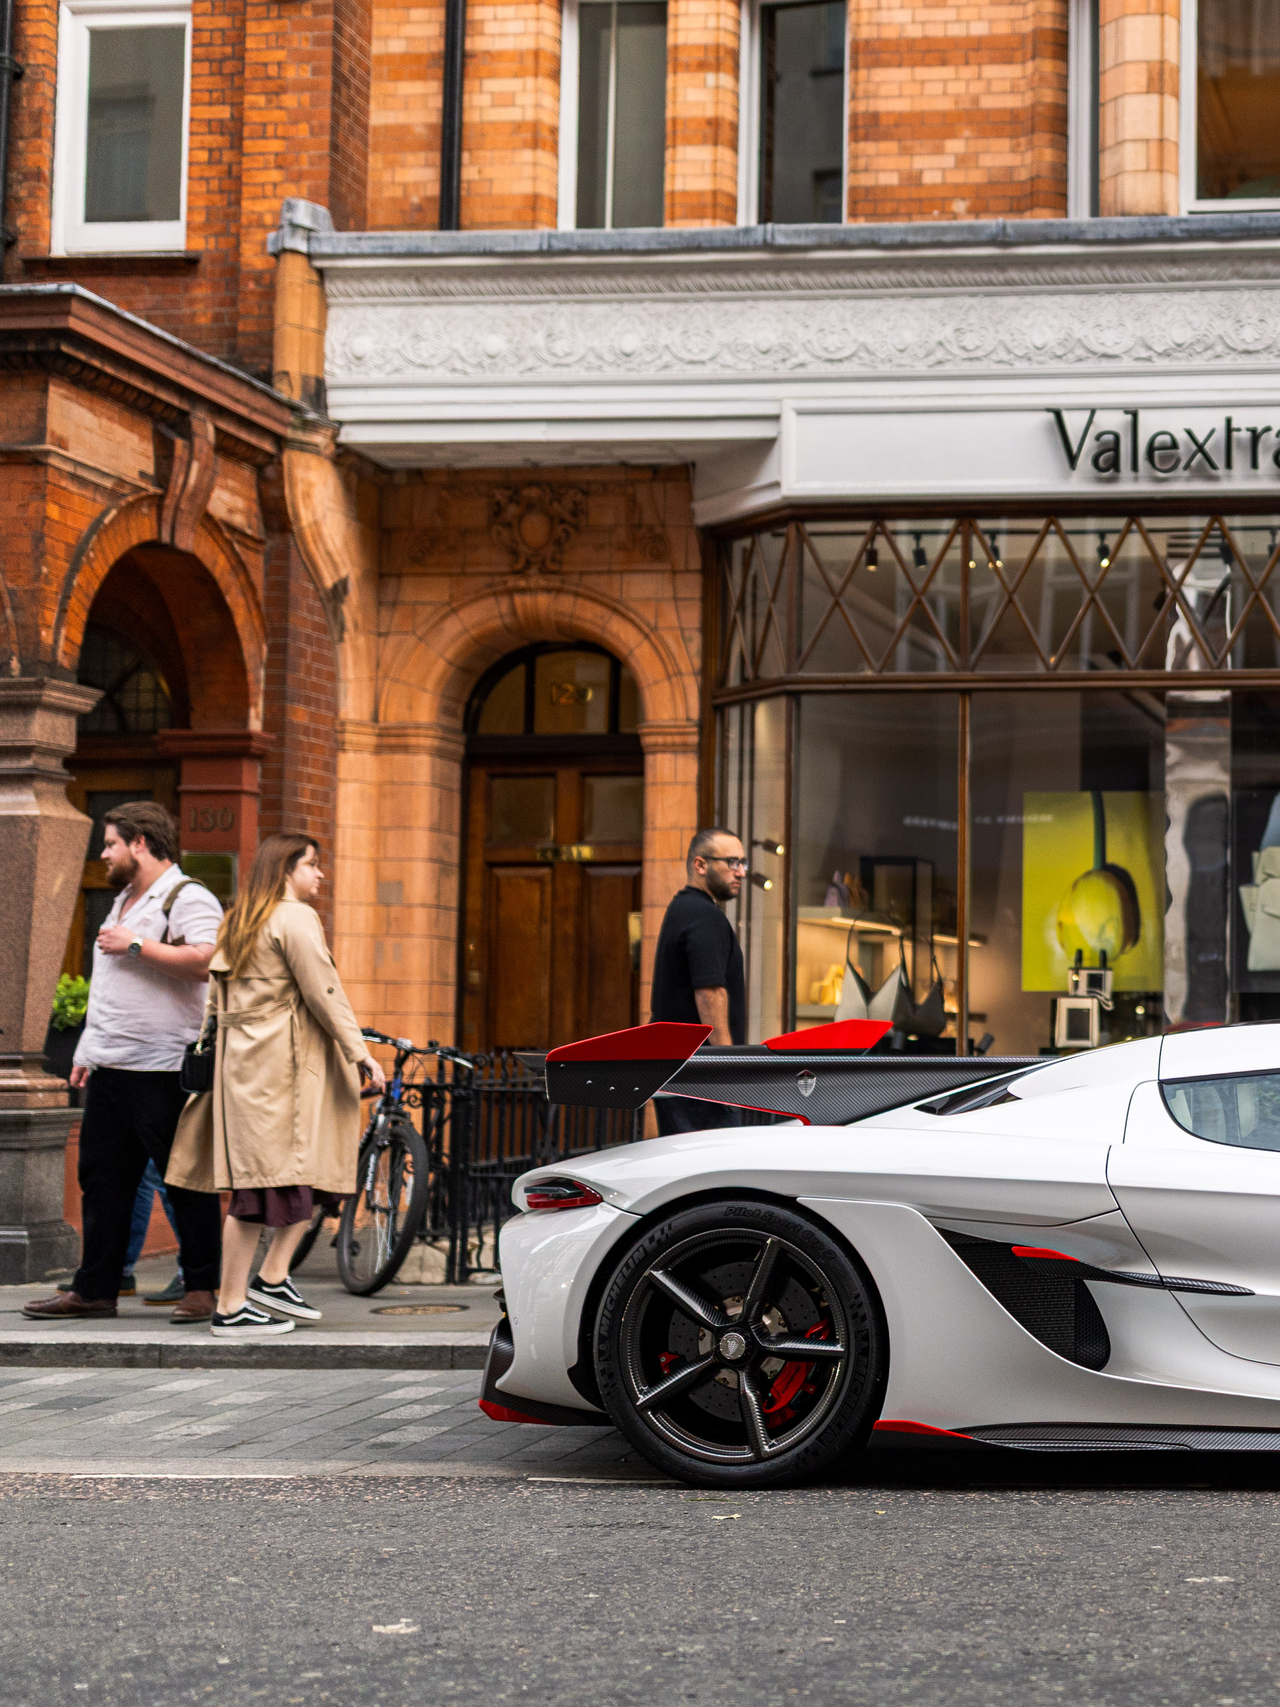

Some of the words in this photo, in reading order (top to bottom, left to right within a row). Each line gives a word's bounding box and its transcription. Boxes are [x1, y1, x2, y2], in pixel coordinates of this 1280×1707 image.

[190, 807, 235, 833] 130
[724, 1206, 761, 1218] Pilot
[761, 1209, 803, 1233] Sport
[801, 1229, 825, 1251] Cup
[823, 1248, 837, 1261] 2
[600, 1245, 646, 1338] MICHELIN
